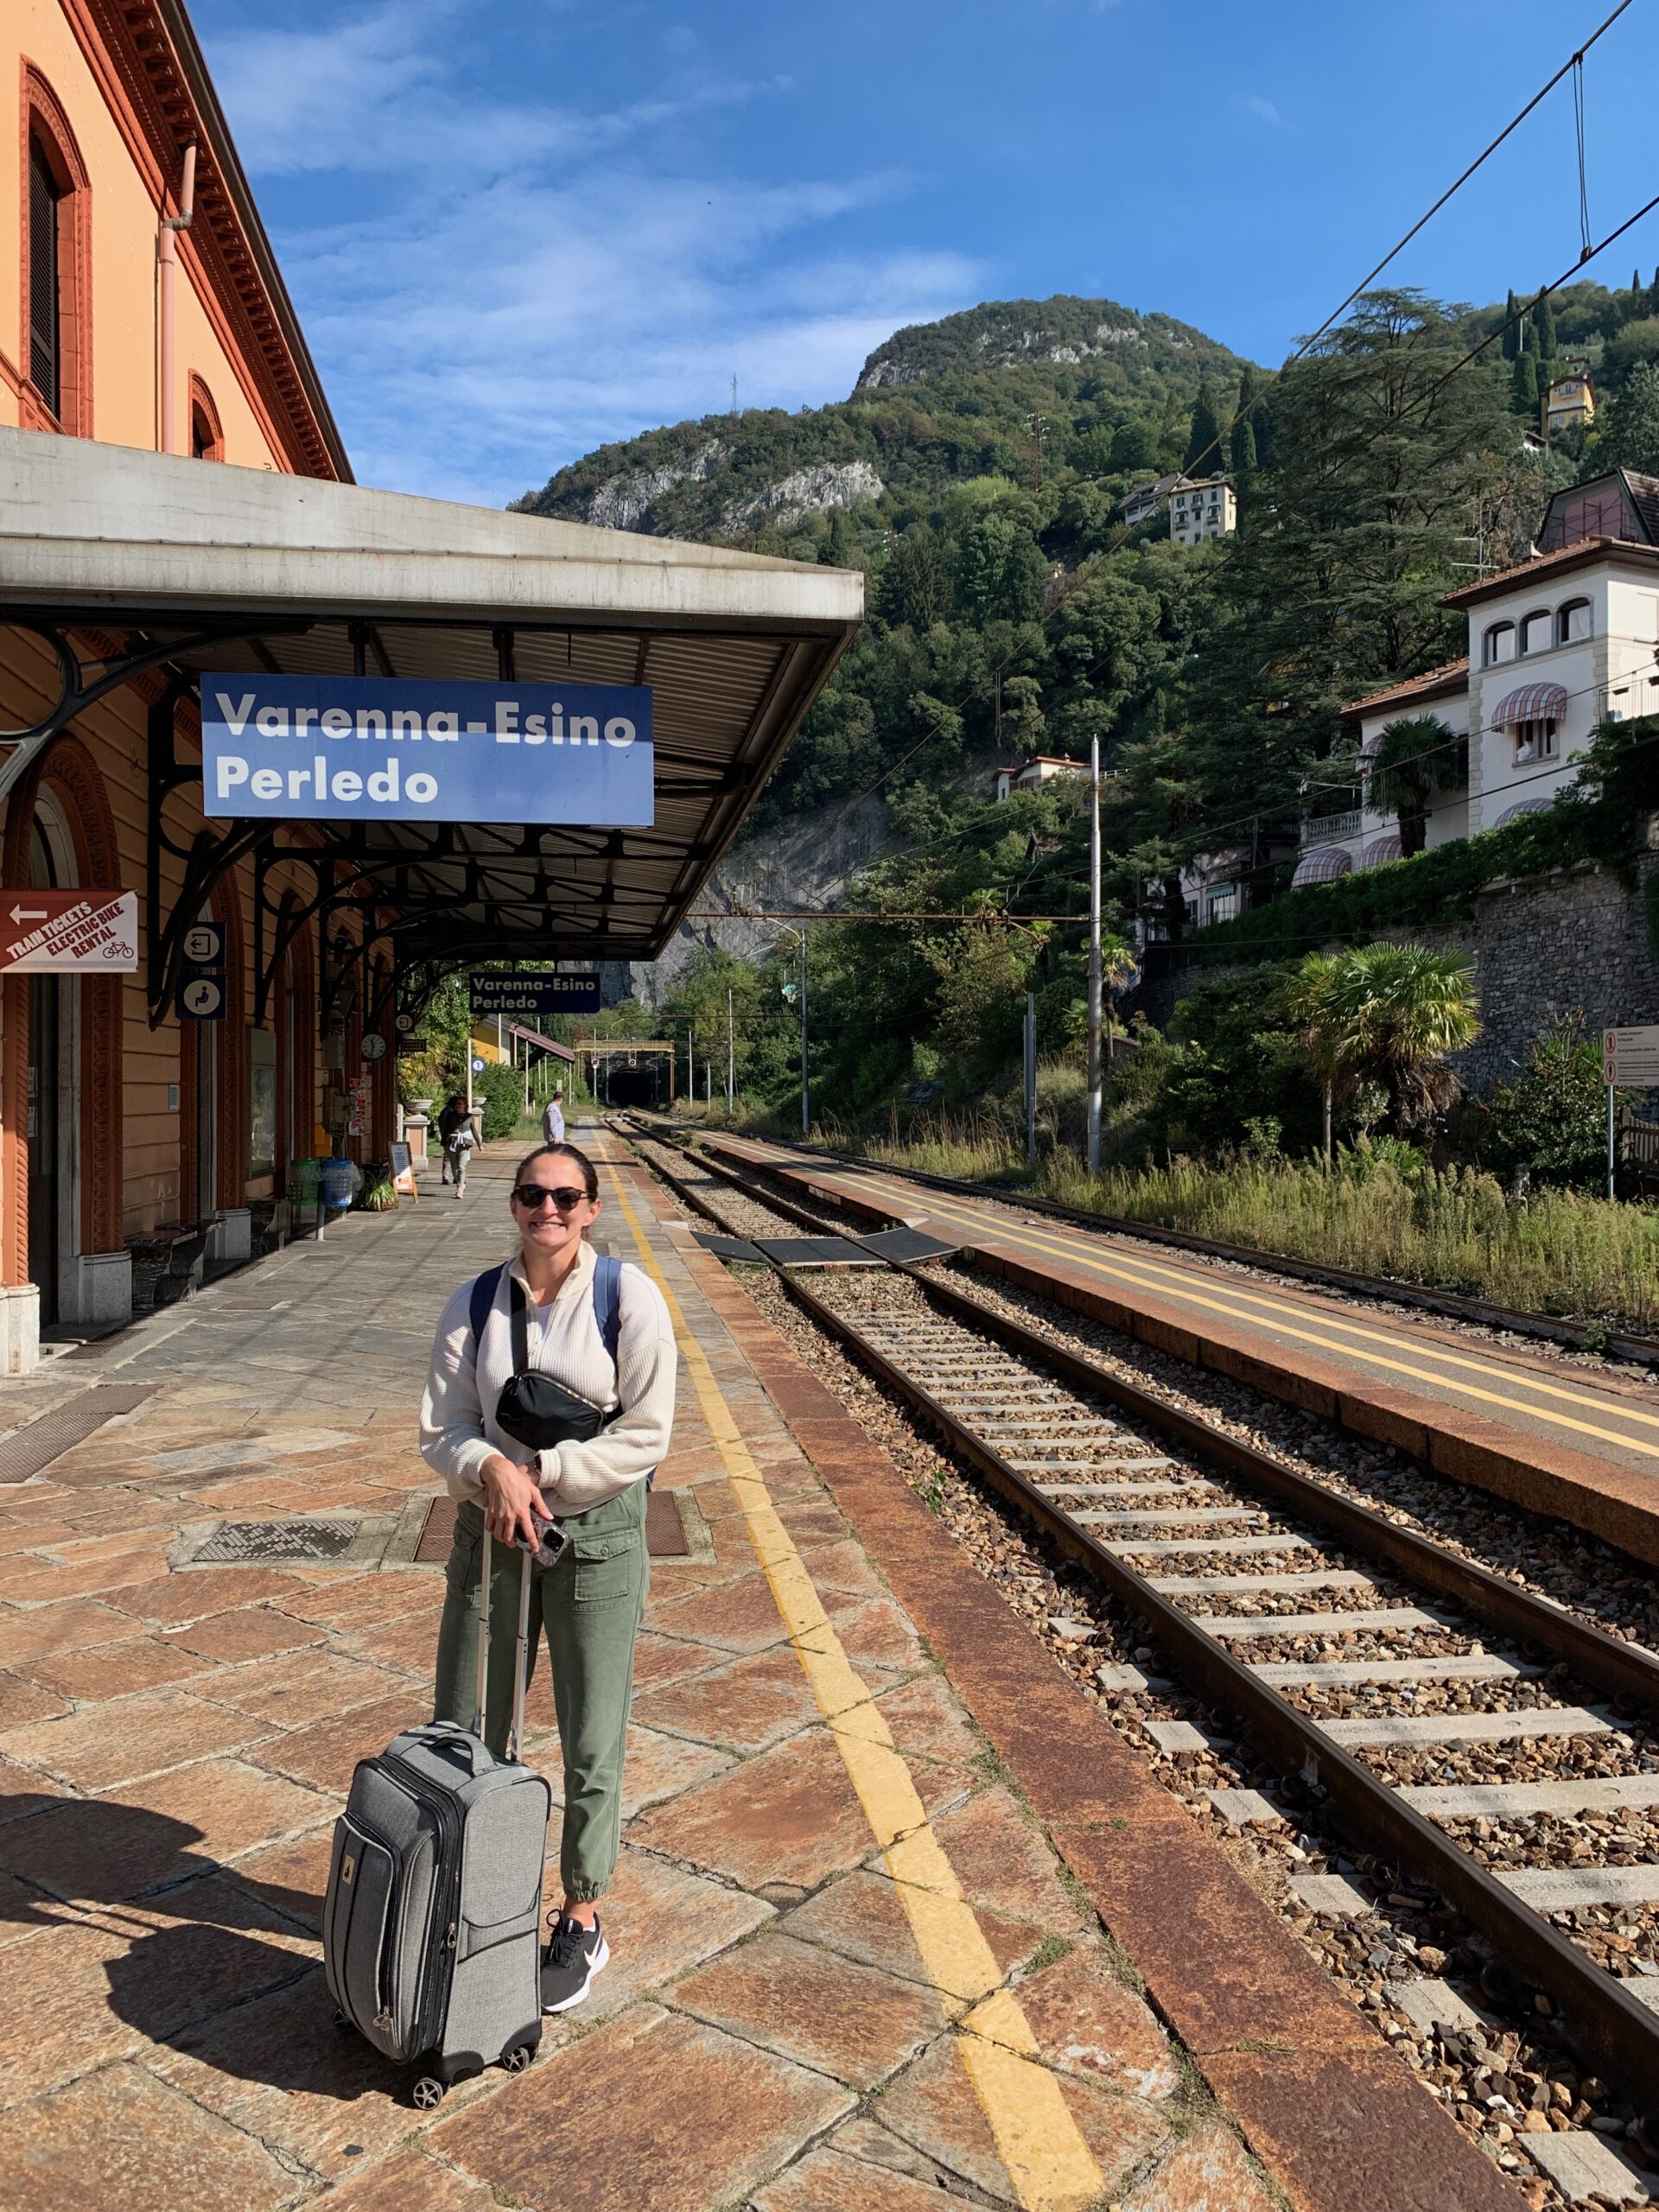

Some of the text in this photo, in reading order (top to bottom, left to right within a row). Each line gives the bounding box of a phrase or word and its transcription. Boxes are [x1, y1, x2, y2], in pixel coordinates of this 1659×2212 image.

[214, 693, 636, 747] Varenna-Esino
[216, 755, 438, 803] Perledo
[6, 901, 92, 959] TRAIN TICKETS
[45, 902, 124, 957] ELECTRIC BIKE
[70, 925, 117, 959] RENTAL
[473, 977, 595, 991] Varenna-Esino
[473, 995, 537, 1008] Perledo
